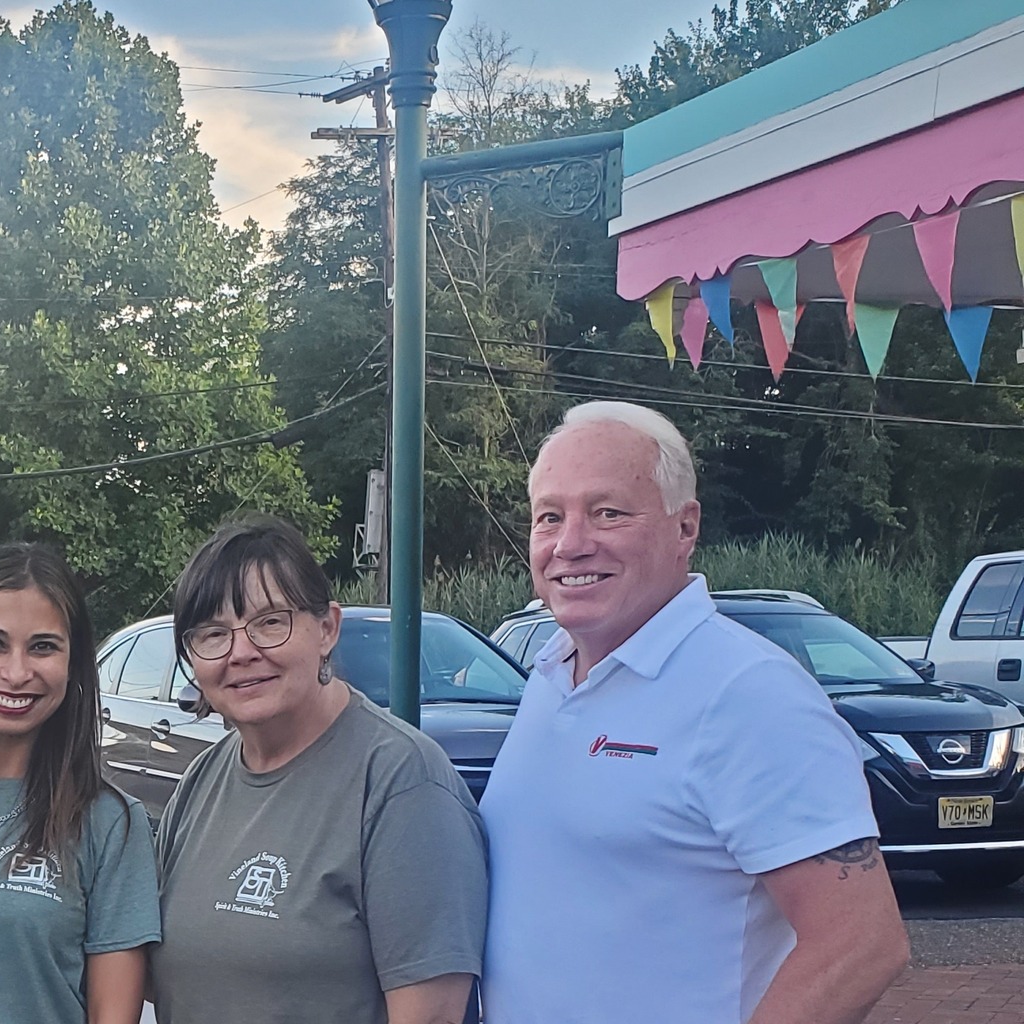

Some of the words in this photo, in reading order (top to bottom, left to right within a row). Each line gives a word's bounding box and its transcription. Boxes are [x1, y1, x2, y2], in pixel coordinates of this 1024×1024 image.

[604, 751, 634, 759] VENEZIA
[941, 805, 961, 821] V70
[967, 804, 989, 820] MSK
[228, 852, 261, 880] Vineland
[261, 851, 278, 865] Soup
[275, 856, 292, 888] Kitchen
[6, 883, 23, 892] Truth
[23, 885, 53, 899] Ministries
[52, 892, 63, 903] Inc.
[268, 910, 280, 919] Inc.
